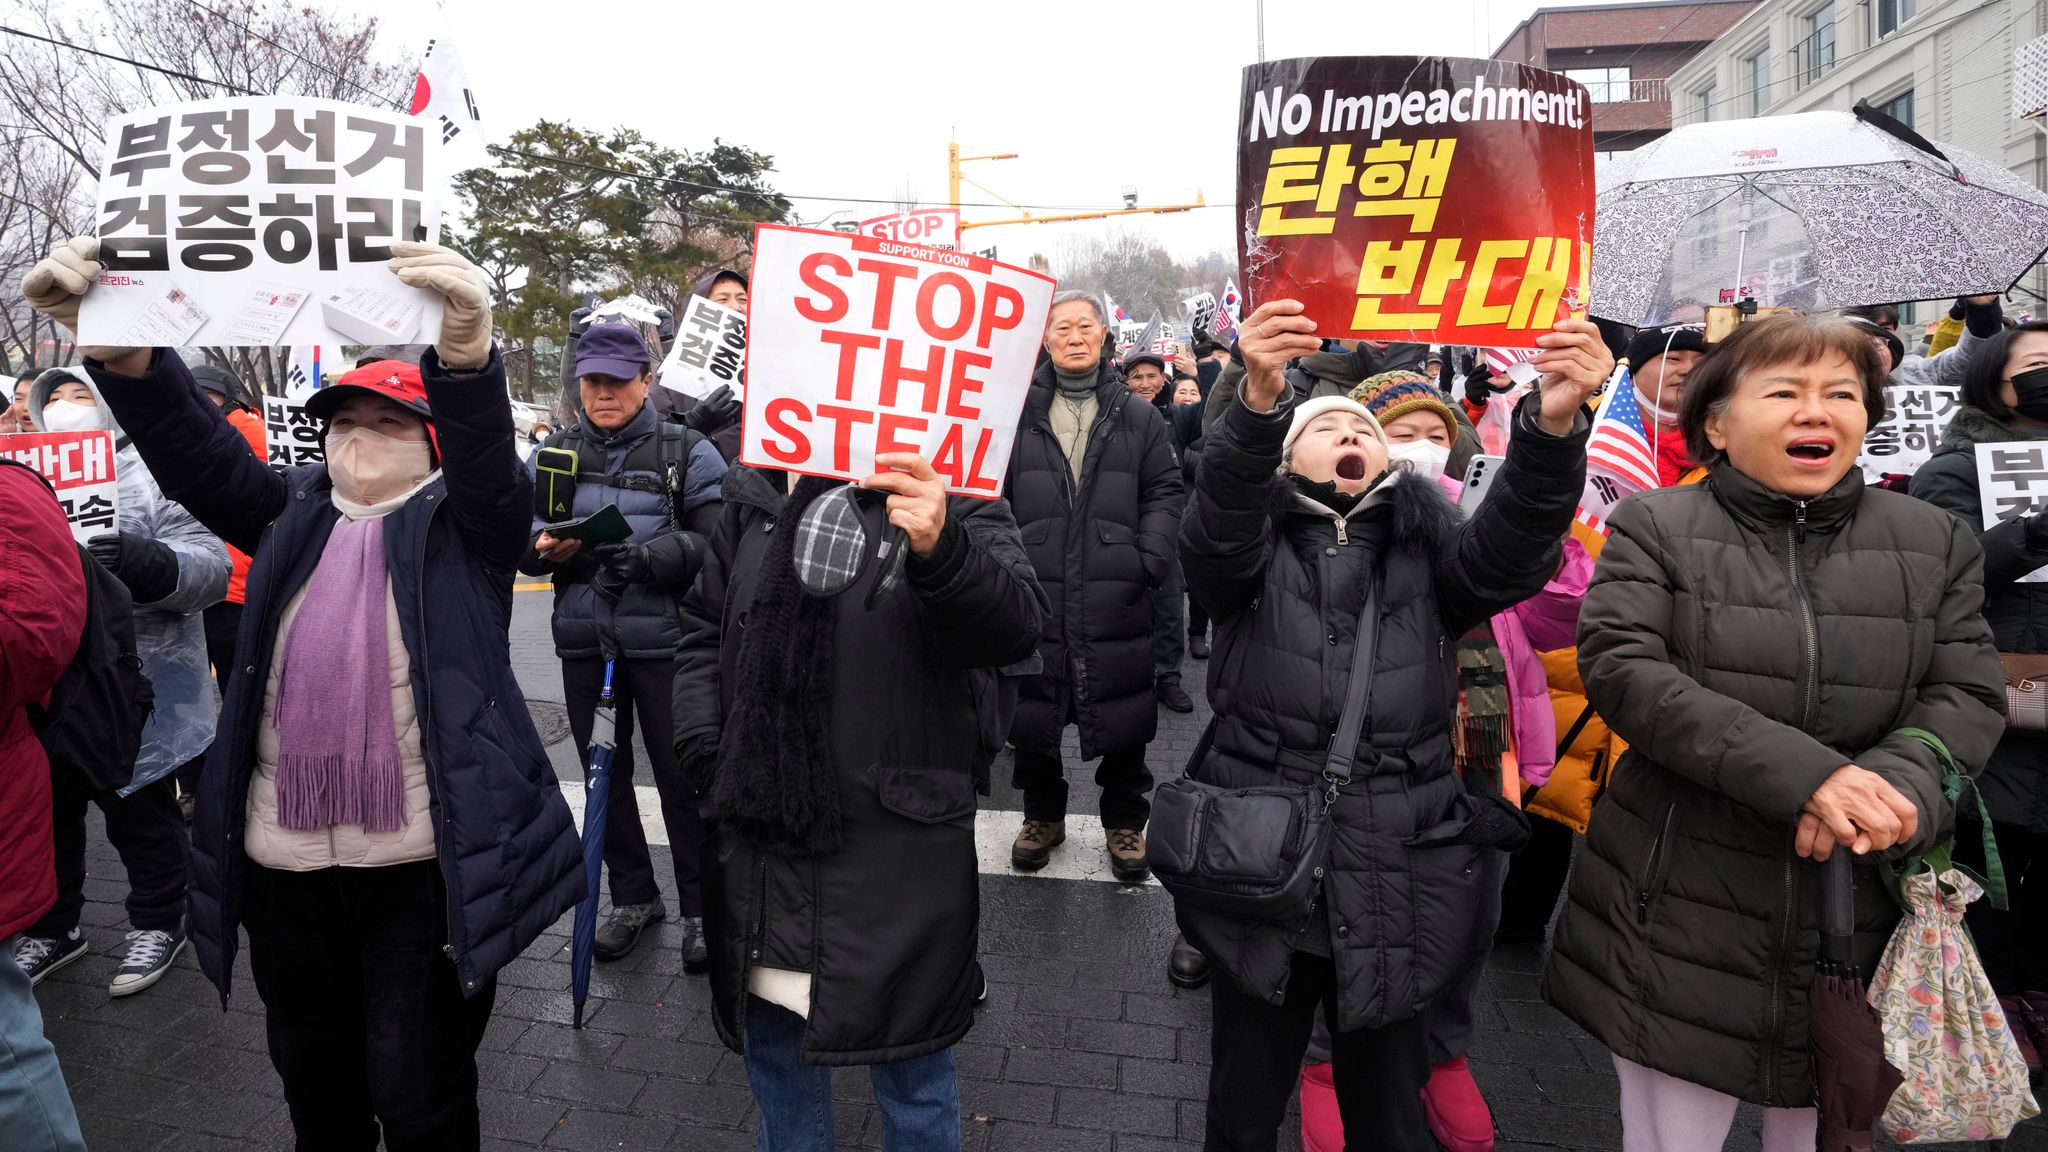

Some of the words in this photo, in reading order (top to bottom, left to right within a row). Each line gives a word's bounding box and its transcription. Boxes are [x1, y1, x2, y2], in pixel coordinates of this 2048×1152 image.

[1320, 75, 1583, 140] Impeachment!
[110, 109, 424, 193] 부정선거
[1257, 138, 1457, 236] 탄핵
[99, 193, 428, 272] 검증하라
[872, 215, 944, 242] STOP
[878, 241, 936, 261] SUPPORT
[937, 252, 970, 268] YOON
[794, 252, 1025, 349] STOP
[820, 329, 992, 420] THE
[761, 398, 1000, 491] STEAL
